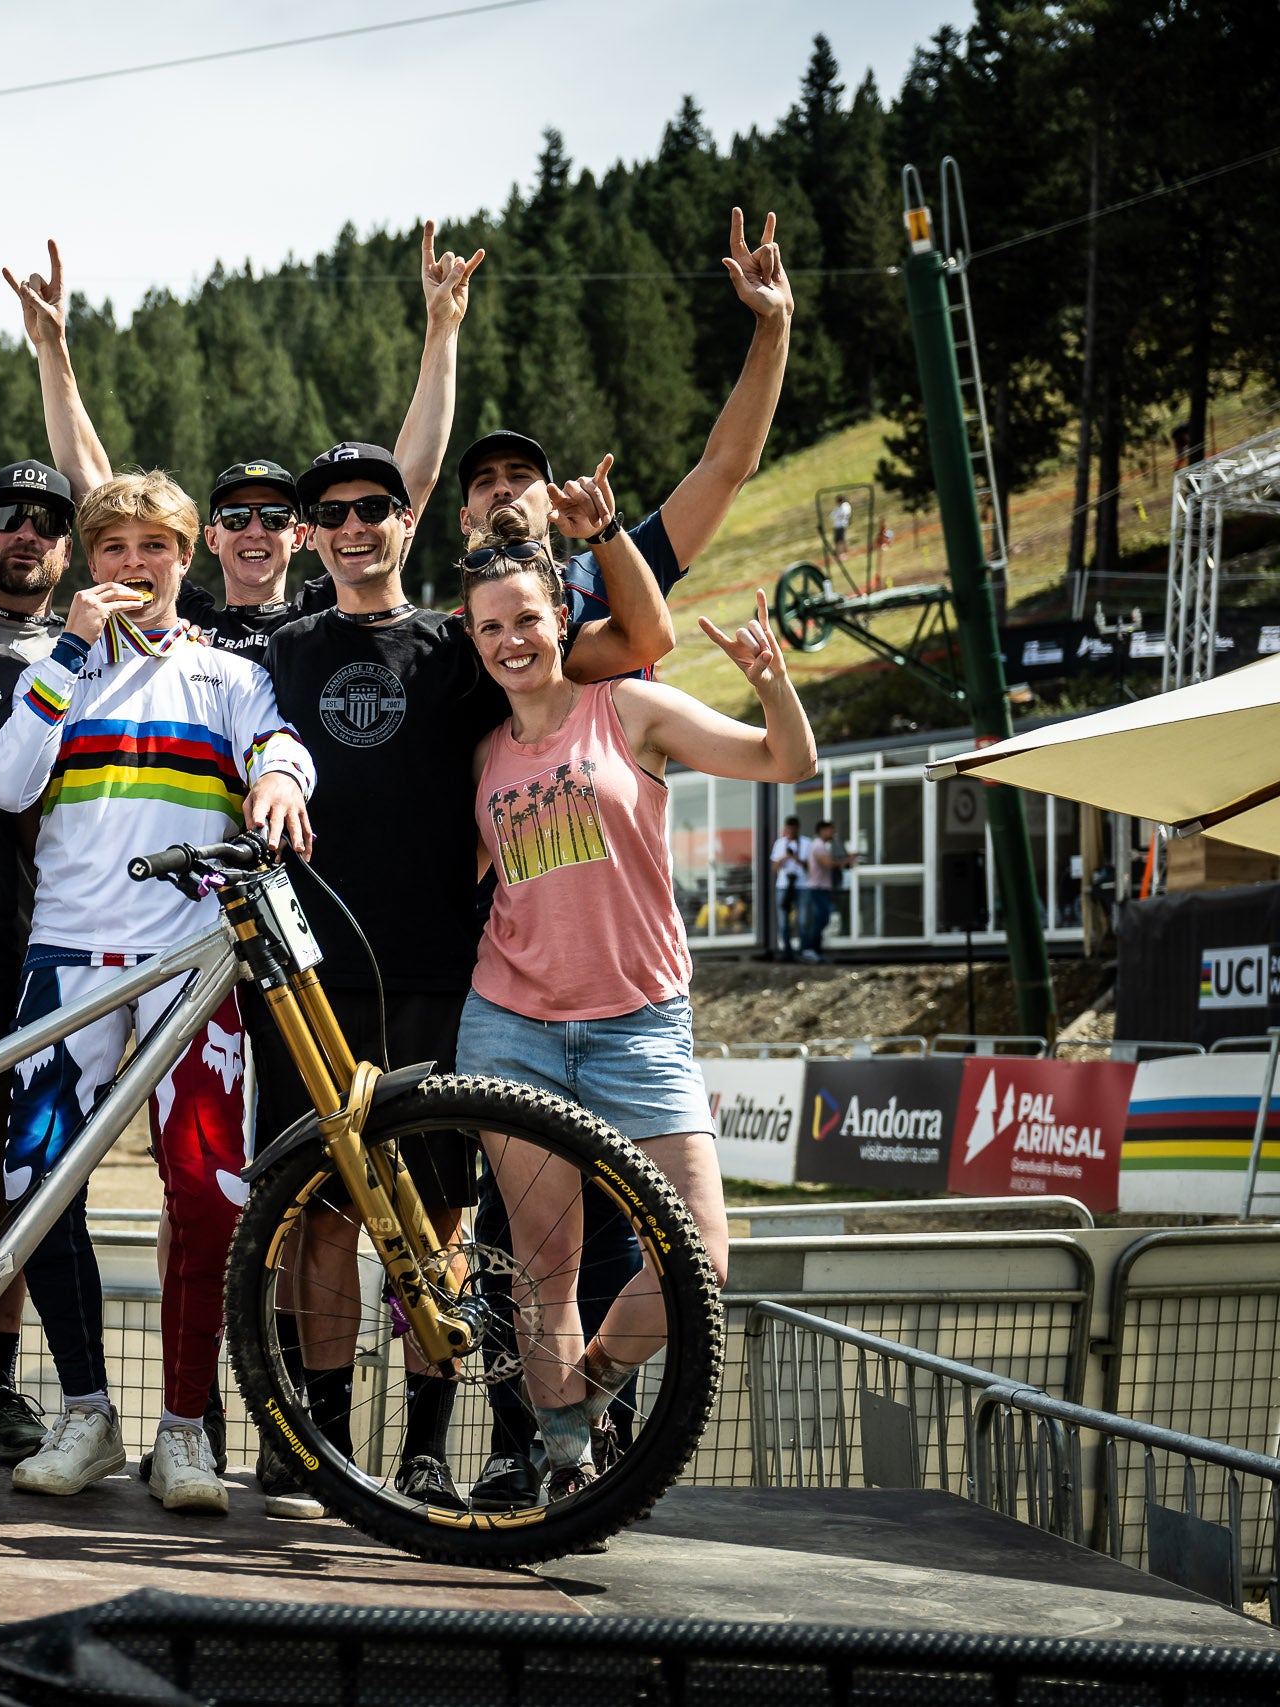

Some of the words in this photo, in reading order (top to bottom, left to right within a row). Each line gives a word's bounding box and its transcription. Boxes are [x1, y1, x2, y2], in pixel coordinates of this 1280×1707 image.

[13, 468, 48, 484] FOX
[326, 665, 363, 694] HANDMADE
[376, 668, 391, 680] THE
[390, 678, 400, 694] USA
[324, 712, 338, 734] OFFICIAL
[340, 732, 351, 742] SEAL
[376, 714, 400, 740] COMPOSITES
[290, 898, 308, 934] 3
[1215, 957, 1263, 998] UCI
[720, 1094, 792, 1142] vittoria
[840, 1095, 942, 1140] Andorra
[1018, 1092, 1056, 1124] PAL
[860, 1144, 940, 1164] visitandorra.com
[1013, 1122, 1106, 1160] ARINSAL
[594, 1160, 644, 1208] KRYPTOTAL
[270, 1408, 320, 1470] Continental
[487, 1458, 514, 1472] NIKE
